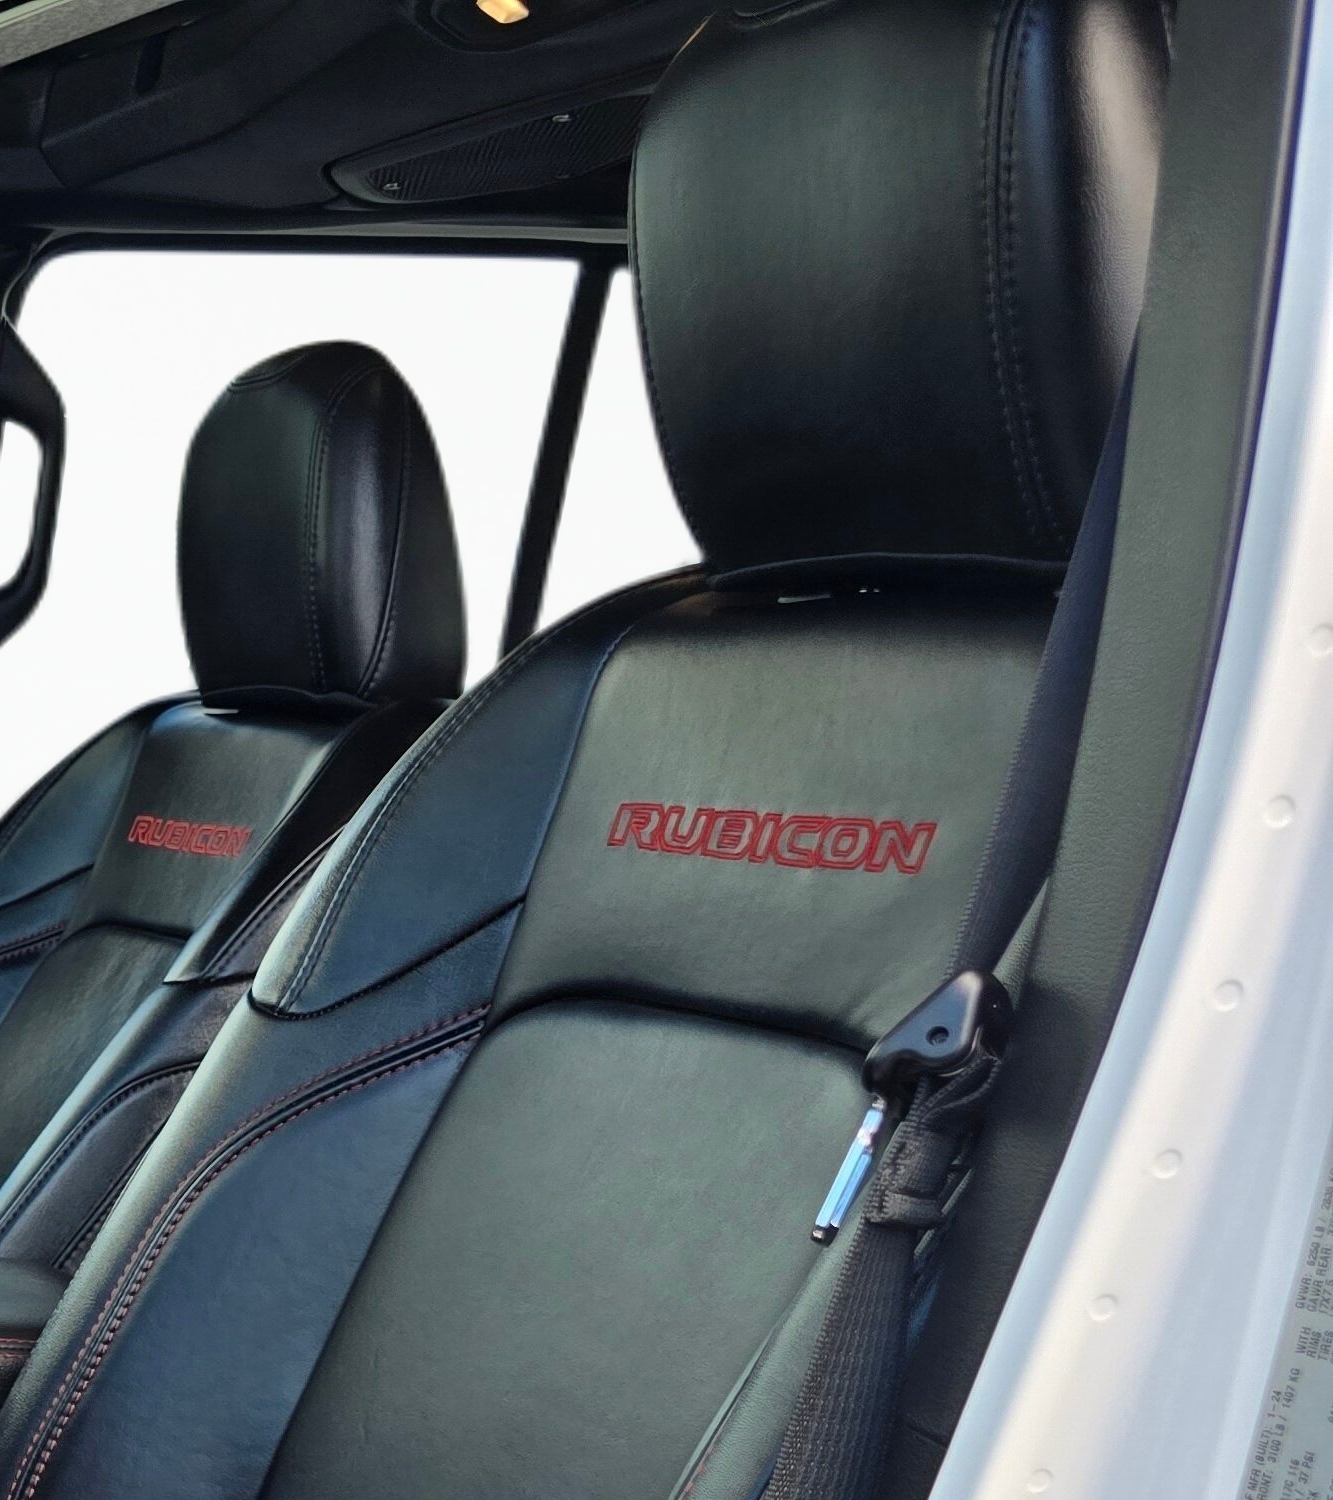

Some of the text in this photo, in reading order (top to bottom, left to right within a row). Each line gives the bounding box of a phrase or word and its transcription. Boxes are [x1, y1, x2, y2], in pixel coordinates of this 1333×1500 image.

[128, 814, 253, 857] RUBICON
[606, 803, 937, 873] RUBICON
[1306, 1276, 1323, 1314] GAWR
[1295, 1324, 1311, 1356] WITH
[1306, 1328, 1321, 1359] RIMS
[1317, 1328, 1333, 1364] TIRES
[1266, 1437, 1281, 1464] 3100
[1288, 1366, 1301, 1384] KG
[1298, 1470, 1309, 1485] 37
[1302, 1450, 1315, 1469] PSI
